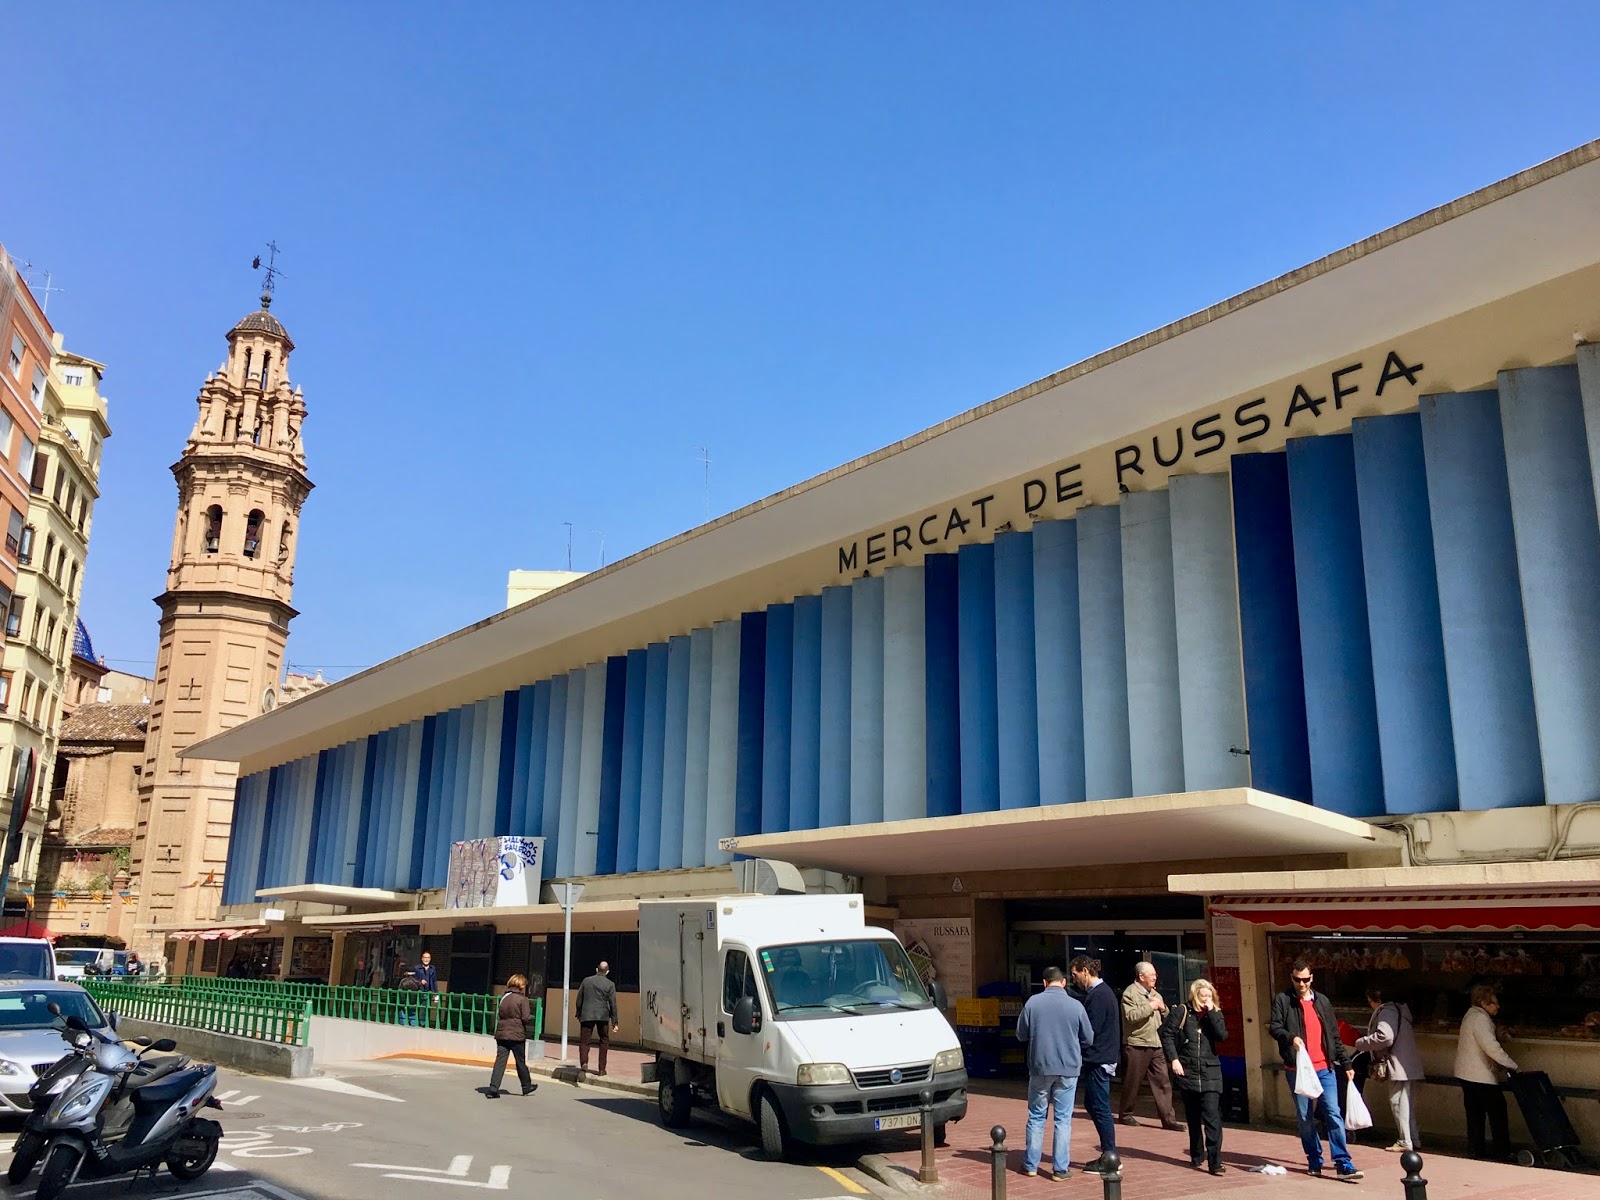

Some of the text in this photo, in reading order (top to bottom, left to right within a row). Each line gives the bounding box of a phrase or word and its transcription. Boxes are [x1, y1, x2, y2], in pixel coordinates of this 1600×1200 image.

[838, 351, 1424, 574] MERCAT DE RUSSAFA
[933, 926, 970, 937] RUSSAFA
[881, 1117, 903, 1129] 7371
